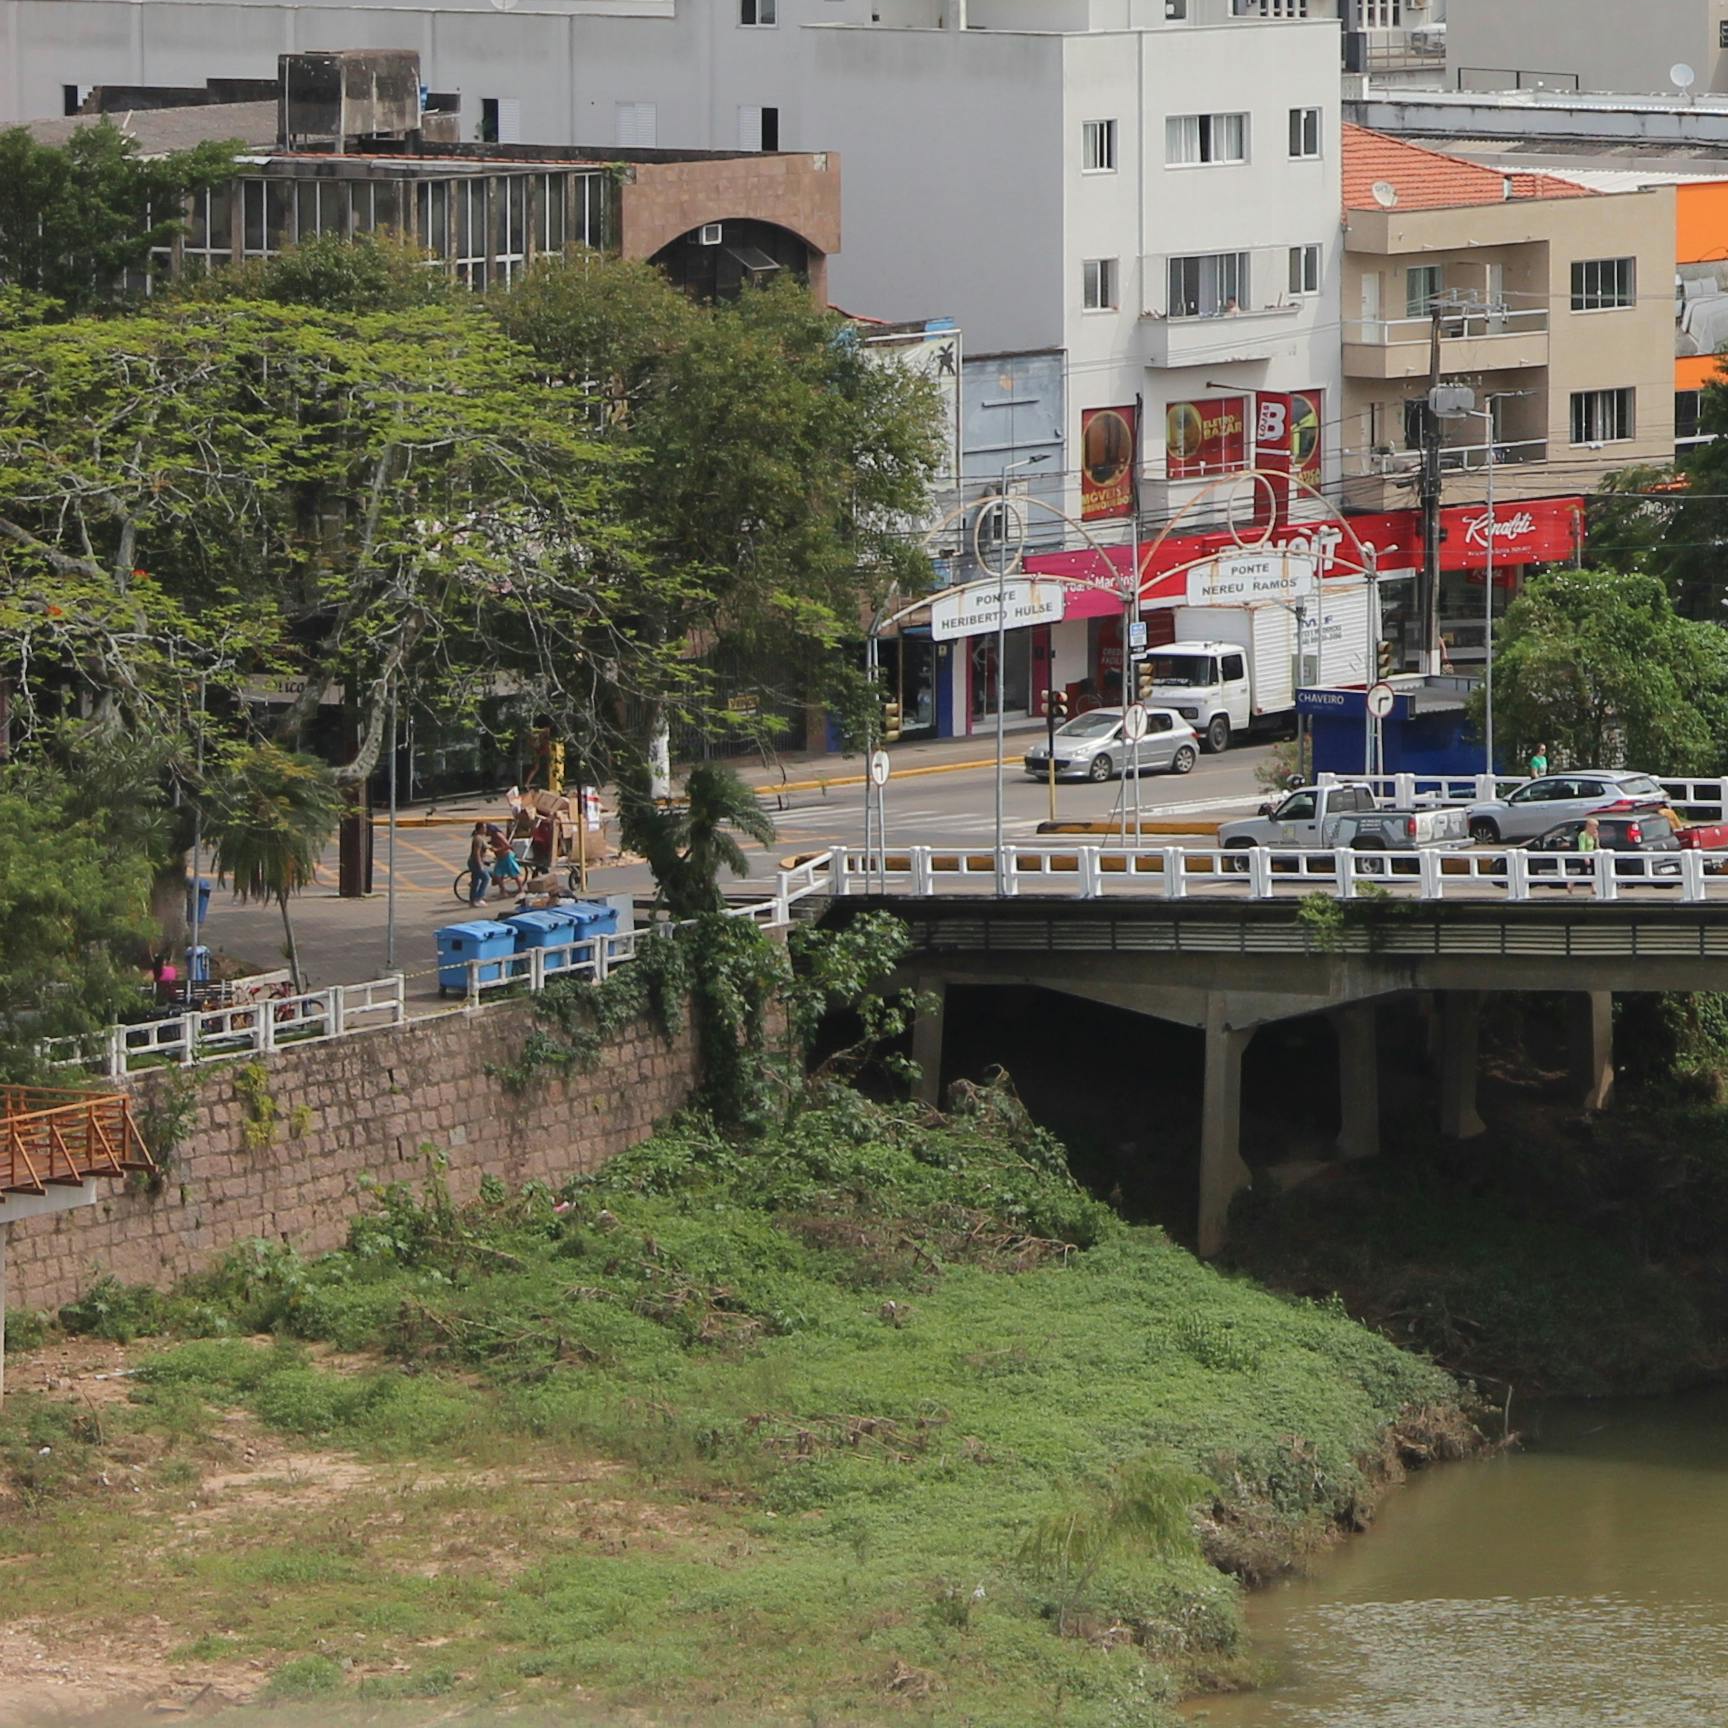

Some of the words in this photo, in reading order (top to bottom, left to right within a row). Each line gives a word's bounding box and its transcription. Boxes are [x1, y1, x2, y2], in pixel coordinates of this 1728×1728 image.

[1203, 422, 1243, 440] BAZAR
[1231, 563, 1270, 575] PONTE
[1202, 581, 1244, 596] NEREU
[1253, 579, 1297, 591] RAMOS
[976, 590, 1016, 606] PONTE
[942, 610, 1008, 630] HERIBERTO
[1298, 693, 1344, 705] CHAVEIRO
